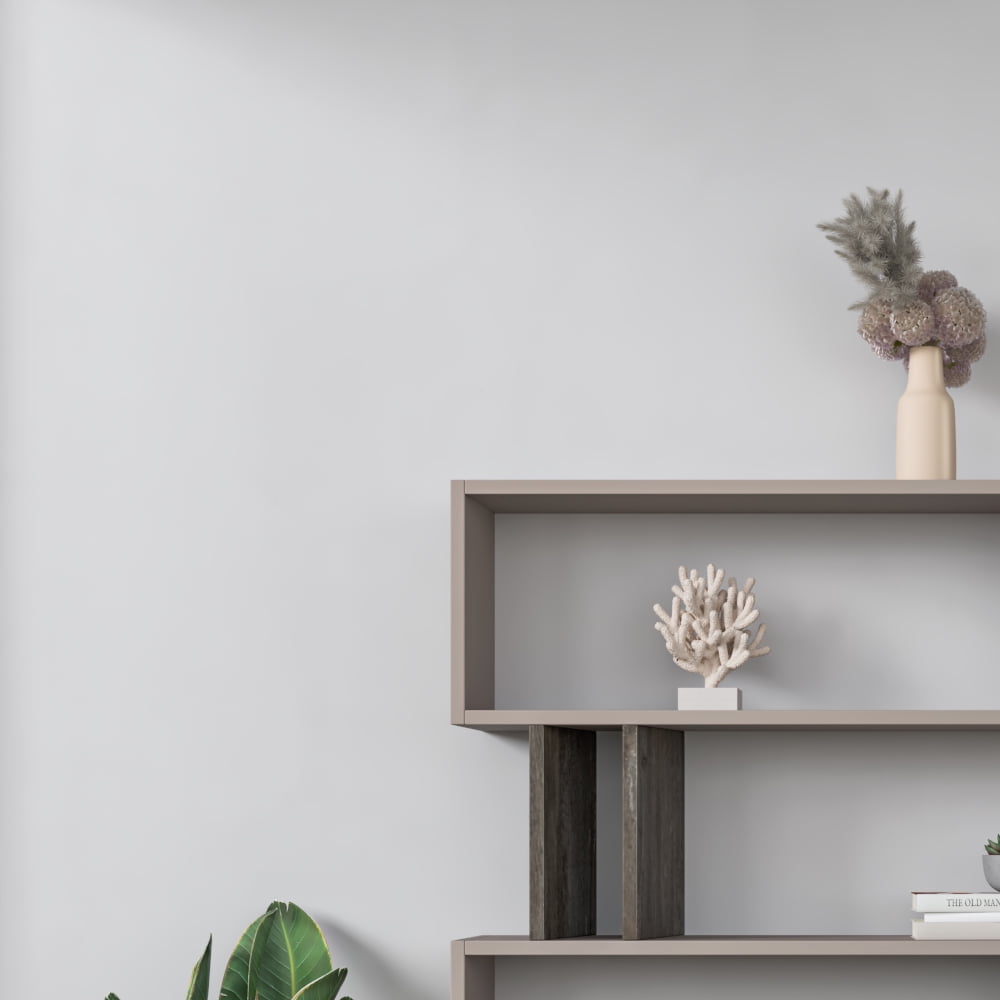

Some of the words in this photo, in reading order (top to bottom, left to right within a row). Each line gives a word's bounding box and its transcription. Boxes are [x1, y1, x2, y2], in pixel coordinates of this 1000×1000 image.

[947, 898, 963, 907] THE
[964, 898, 982, 907] OLD
[983, 898, 1000, 907] MAN
